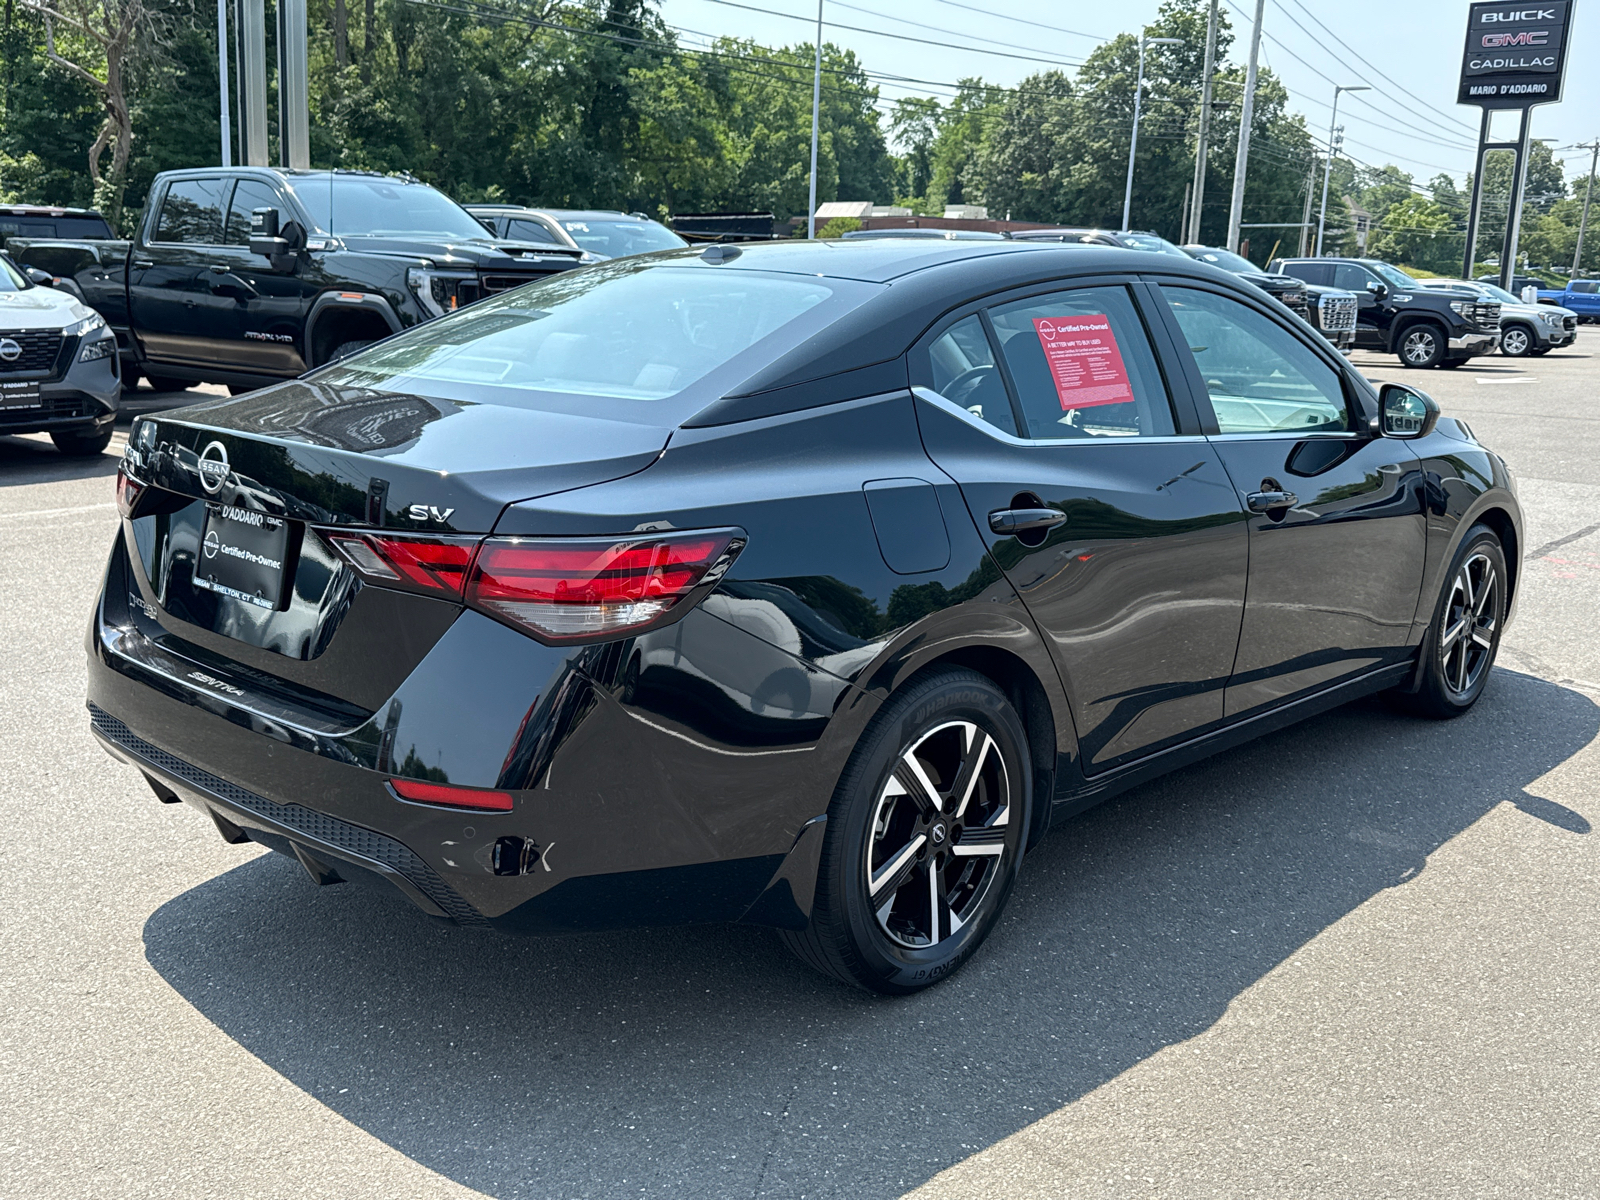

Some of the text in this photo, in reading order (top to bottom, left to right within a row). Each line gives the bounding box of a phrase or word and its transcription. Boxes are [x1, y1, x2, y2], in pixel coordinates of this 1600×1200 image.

[1481, 9, 1555, 23] BUICK
[1482, 31, 1549, 48] GMC
[1469, 57, 1555, 69] CADILLAC
[1469, 84, 1548, 95] MARIO D'ADDARIO
[1057, 323, 1109, 333] Certified Pre-Owned
[202, 462, 229, 475] SSAN
[222, 505, 263, 527] D'ADDARIO
[266, 516, 283, 527] GMC
[409, 504, 455, 523] SV
[203, 540, 219, 549] NISSAN
[221, 544, 246, 559] Certified
[213, 584, 241, 600] SHELTON,
[241, 594, 251, 602] CT
